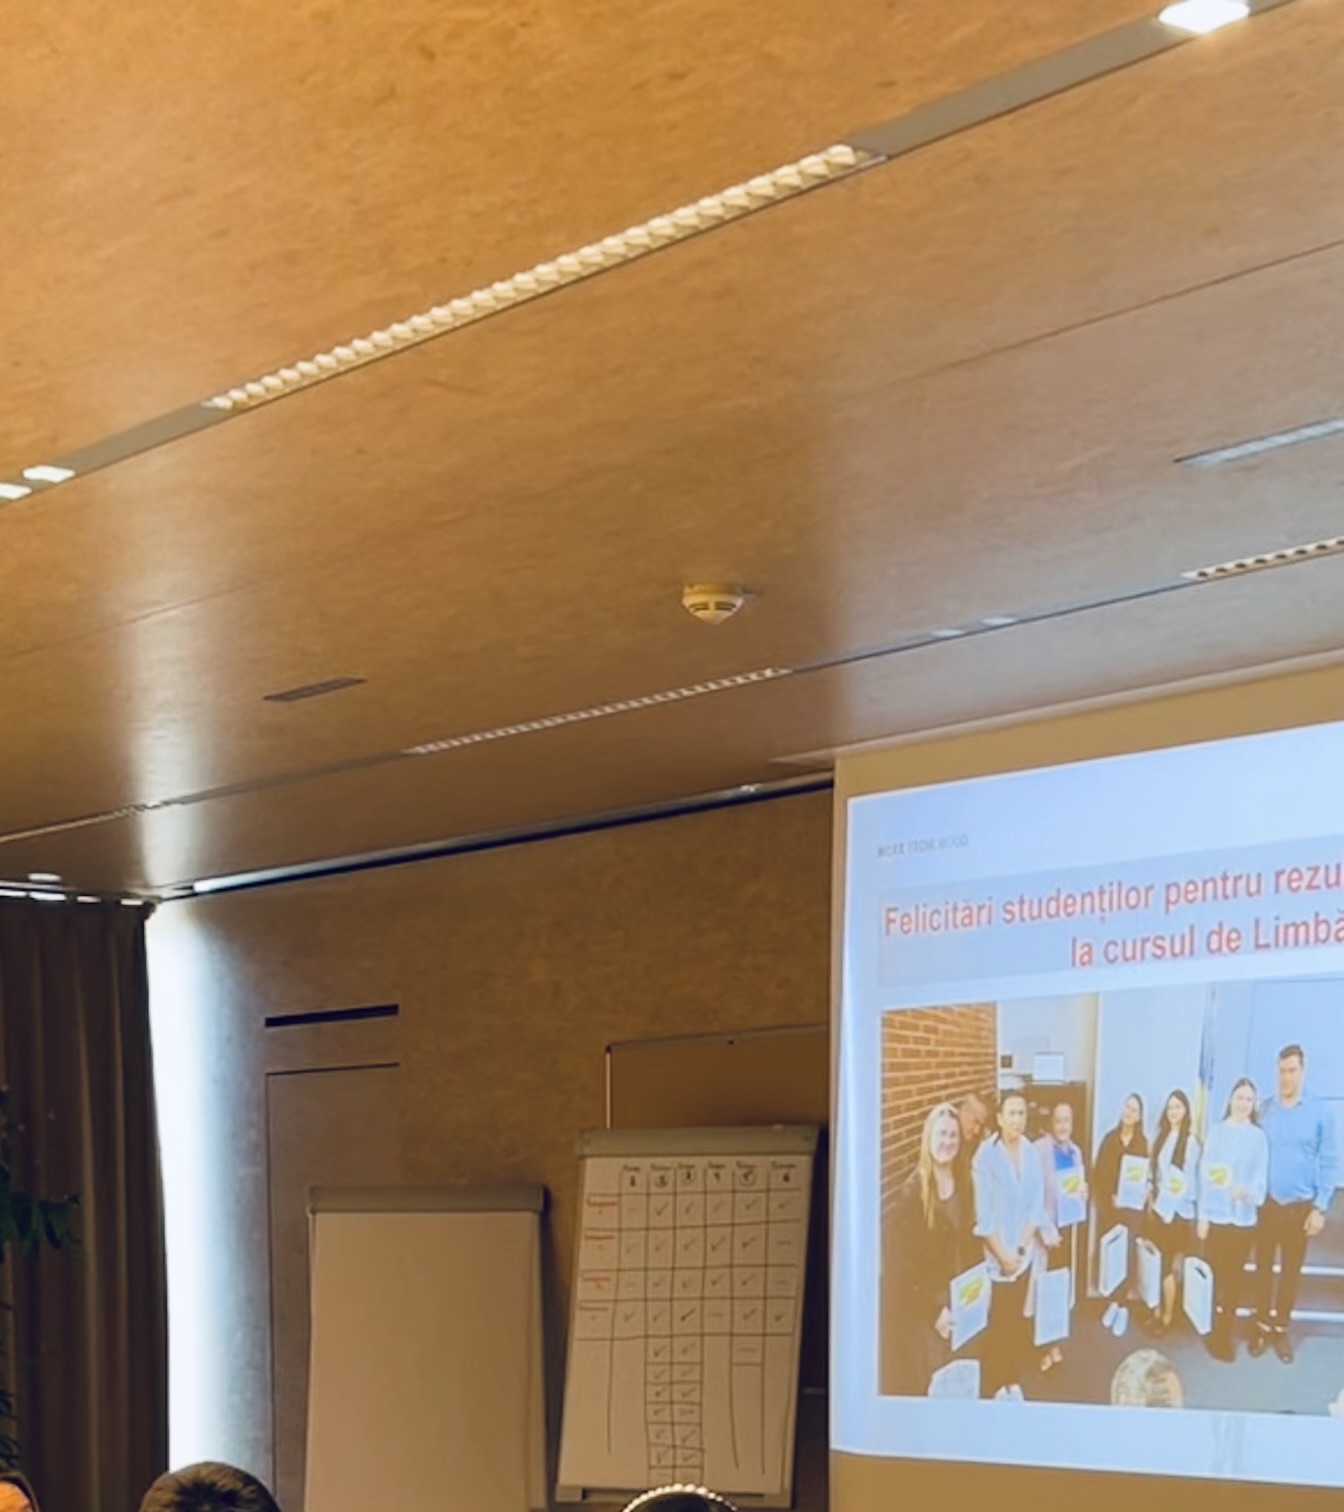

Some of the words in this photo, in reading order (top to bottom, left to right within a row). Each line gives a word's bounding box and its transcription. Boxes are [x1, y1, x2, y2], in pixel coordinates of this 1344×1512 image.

[885, 896, 993, 936] Felicitări
[1001, 881, 1154, 925] studenților
[1165, 870, 1263, 911] pentru
[1071, 936, 1094, 967] la
[1104, 924, 1195, 964] cursul
[1206, 921, 1241, 955] de
